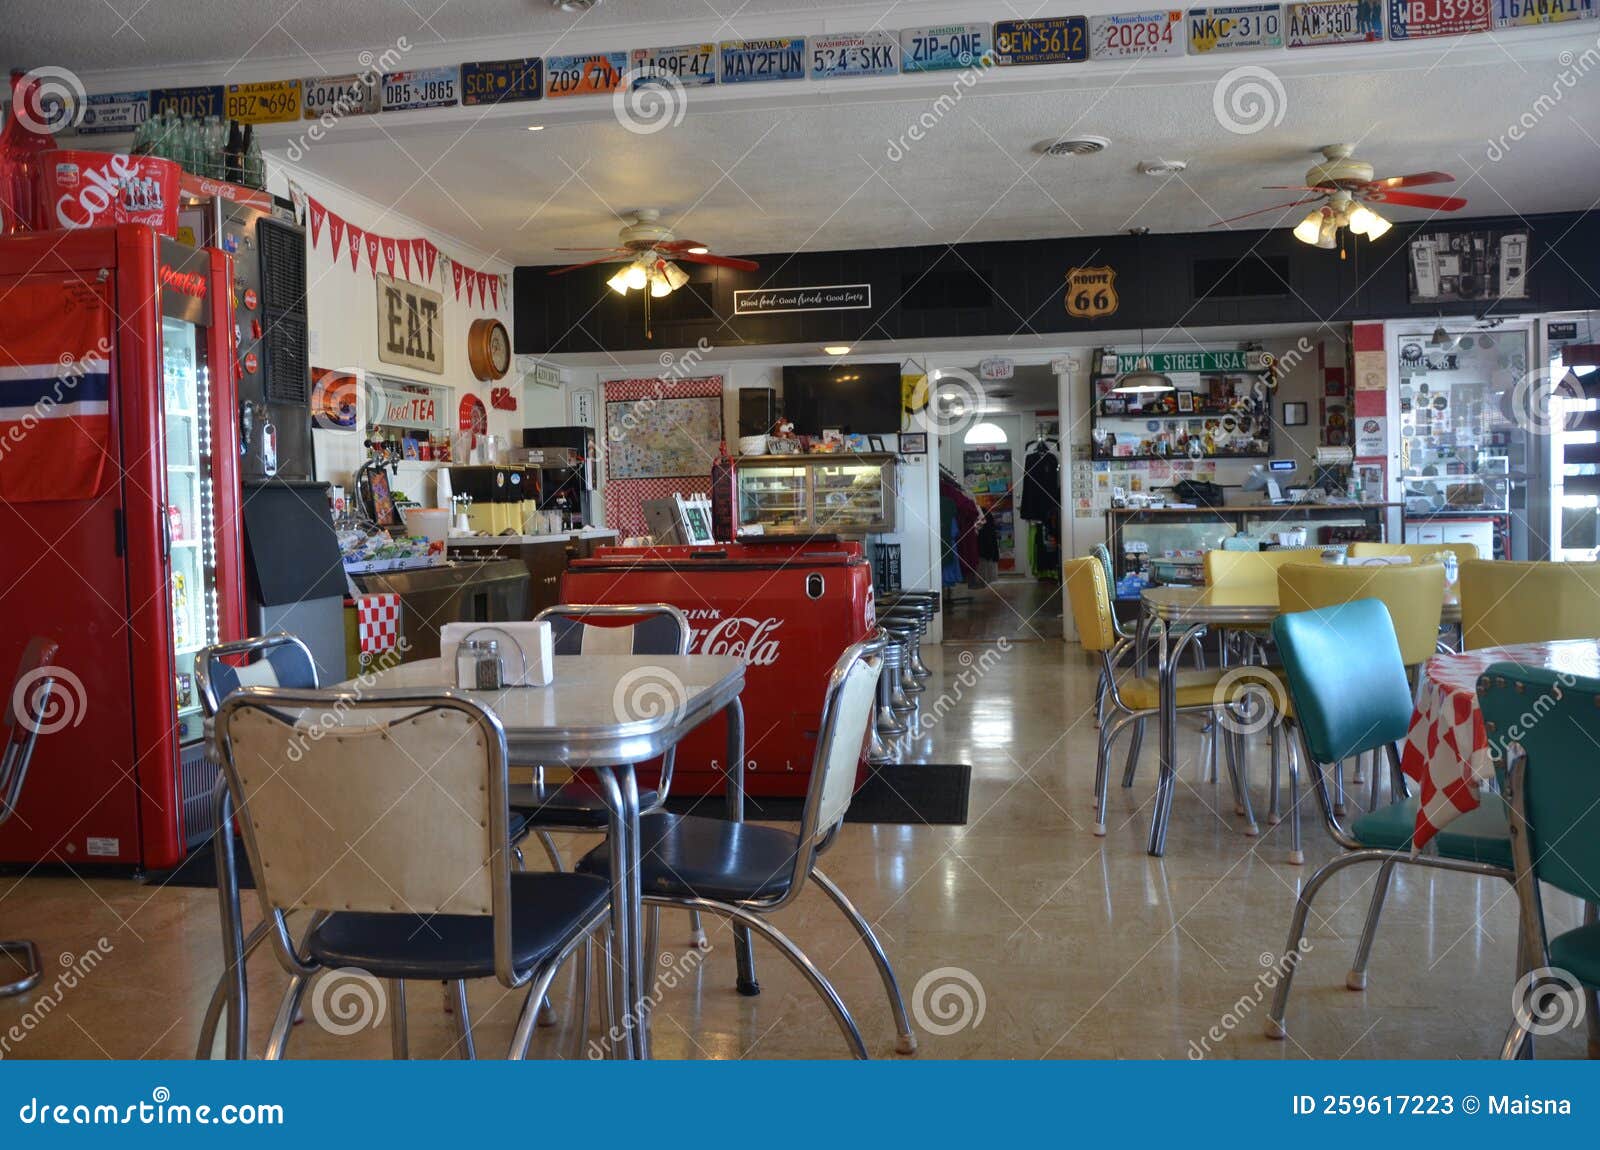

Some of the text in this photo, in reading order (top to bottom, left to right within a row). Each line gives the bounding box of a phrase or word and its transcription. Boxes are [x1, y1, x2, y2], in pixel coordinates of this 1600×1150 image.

[1300, 5, 1354, 15] MONTANA
[1399, 1, 1485, 24] WBJ398
[1106, 21, 1173, 48] 20284
[1192, 15, 1278, 40] NKC-310
[743, 40, 784, 50] NEVADA
[815, 39, 865, 49] WASHINGTON
[912, 33, 982, 61] ZIP-ONE
[637, 53, 710, 79] 1A89F47
[723, 51, 801, 76] WAY2FUN
[243, 80, 285, 93] ALASKA
[420, 79, 454, 101] J865
[466, 73, 495, 95] SCR
[228, 96, 257, 118] BBZ
[268, 91, 297, 114] 696
[56, 154, 139, 229] Coke
[1073, 274, 1109, 285] ROUTE
[1074, 288, 1109, 311] 66
[384, 286, 438, 362] EAT
[1163, 353, 1206, 370] STREET
[1215, 352, 1242, 369] USA
[387, 399, 435, 422] Iced TEA
